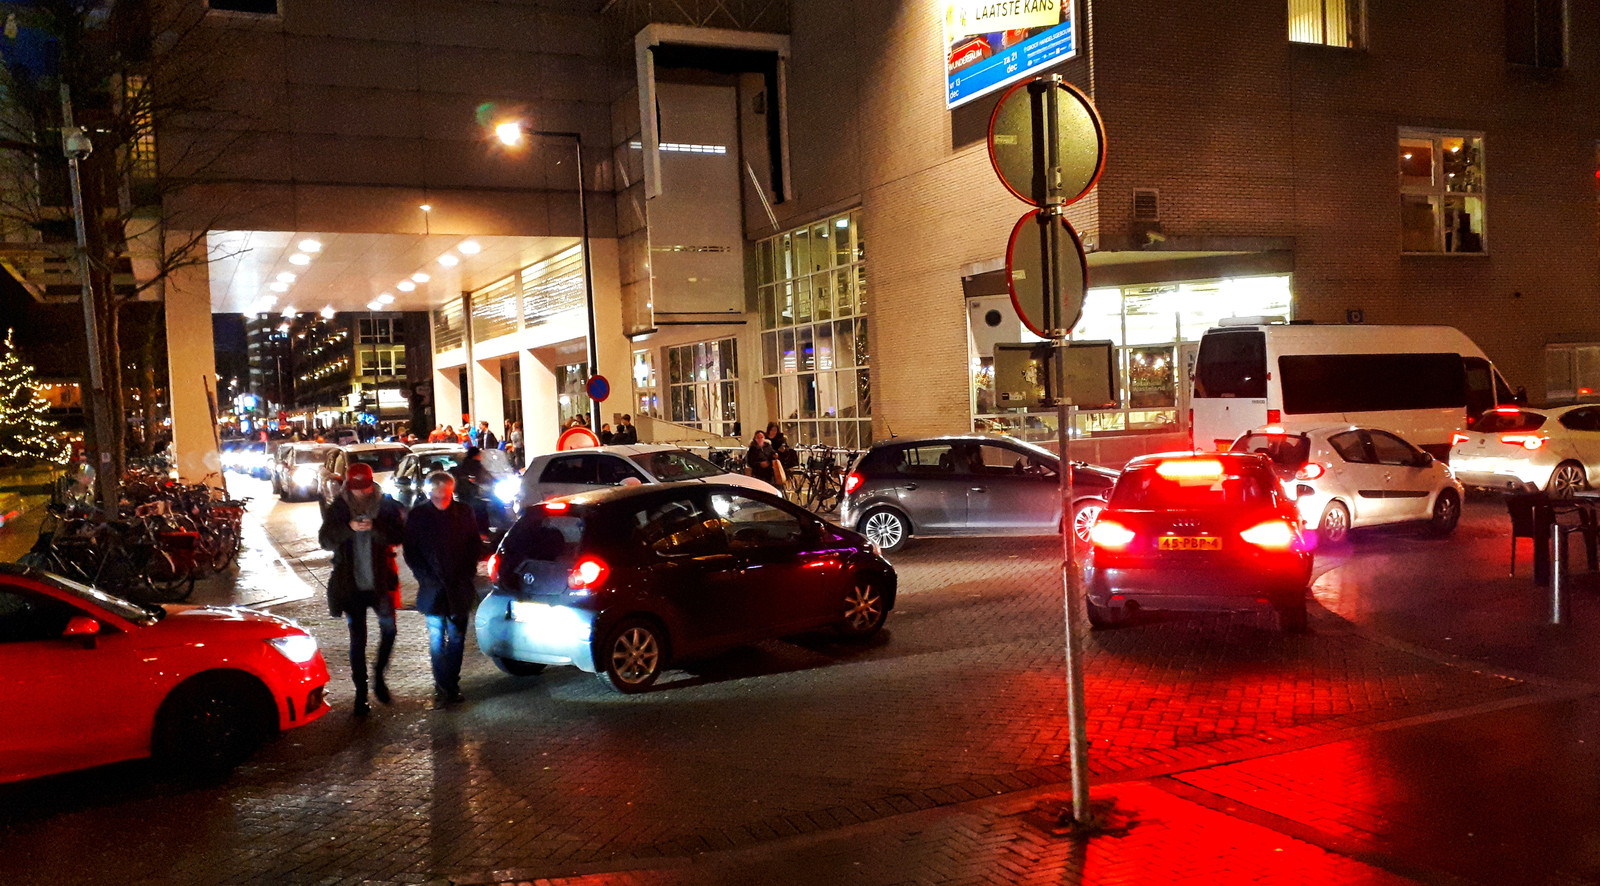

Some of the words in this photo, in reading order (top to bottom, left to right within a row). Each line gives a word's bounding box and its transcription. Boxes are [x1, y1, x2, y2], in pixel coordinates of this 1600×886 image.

[976, 0, 1020, 20] LAATSTE
[1023, 0, 1054, 13] KANS
[1011, 51, 1018, 61] 21
[1006, 63, 1018, 73] dec
[955, 77, 961, 87] 13
[949, 89, 959, 99] dec
[1161, 537, 1219, 549] 45-PBP-4
